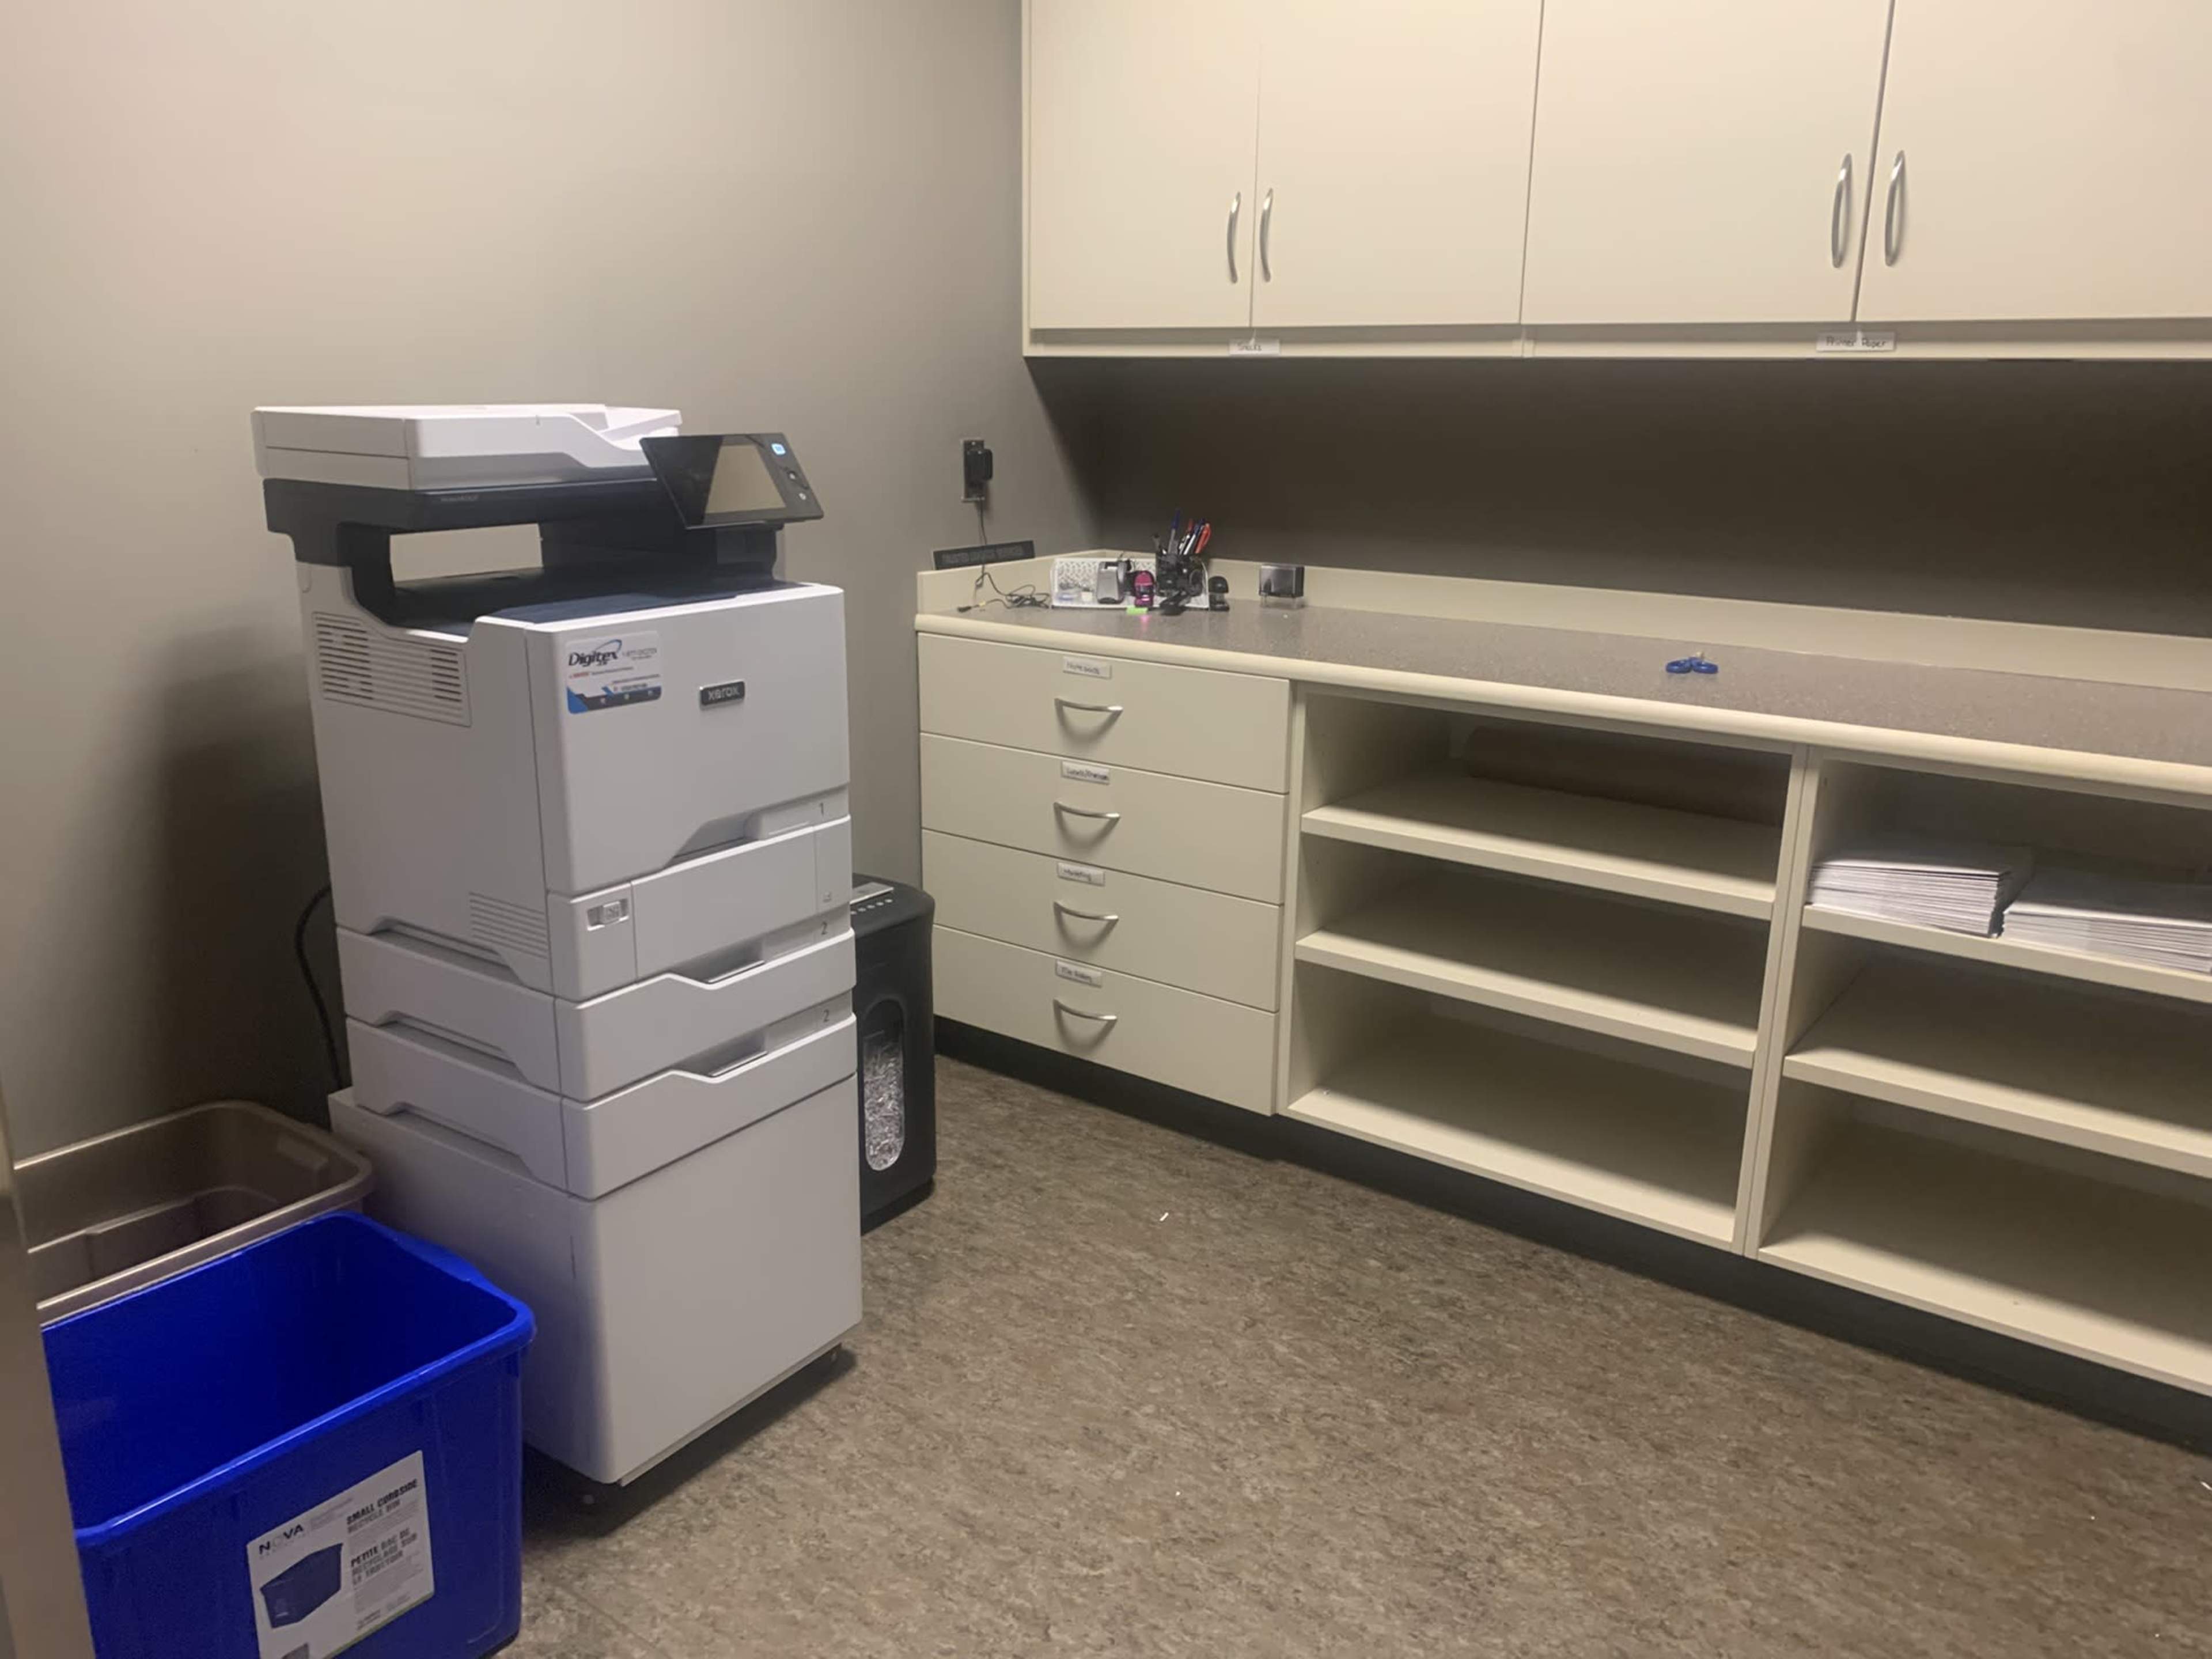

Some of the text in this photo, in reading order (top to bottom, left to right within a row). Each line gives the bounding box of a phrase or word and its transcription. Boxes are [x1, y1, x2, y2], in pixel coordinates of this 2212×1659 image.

[568, 651, 619, 668] Digitex
[709, 686, 740, 701] xerox
[820, 921, 828, 936] 2
[823, 1009, 830, 1023] 2
[347, 1503, 374, 1525] SMALL
[351, 1546, 378, 1567] PETITE
